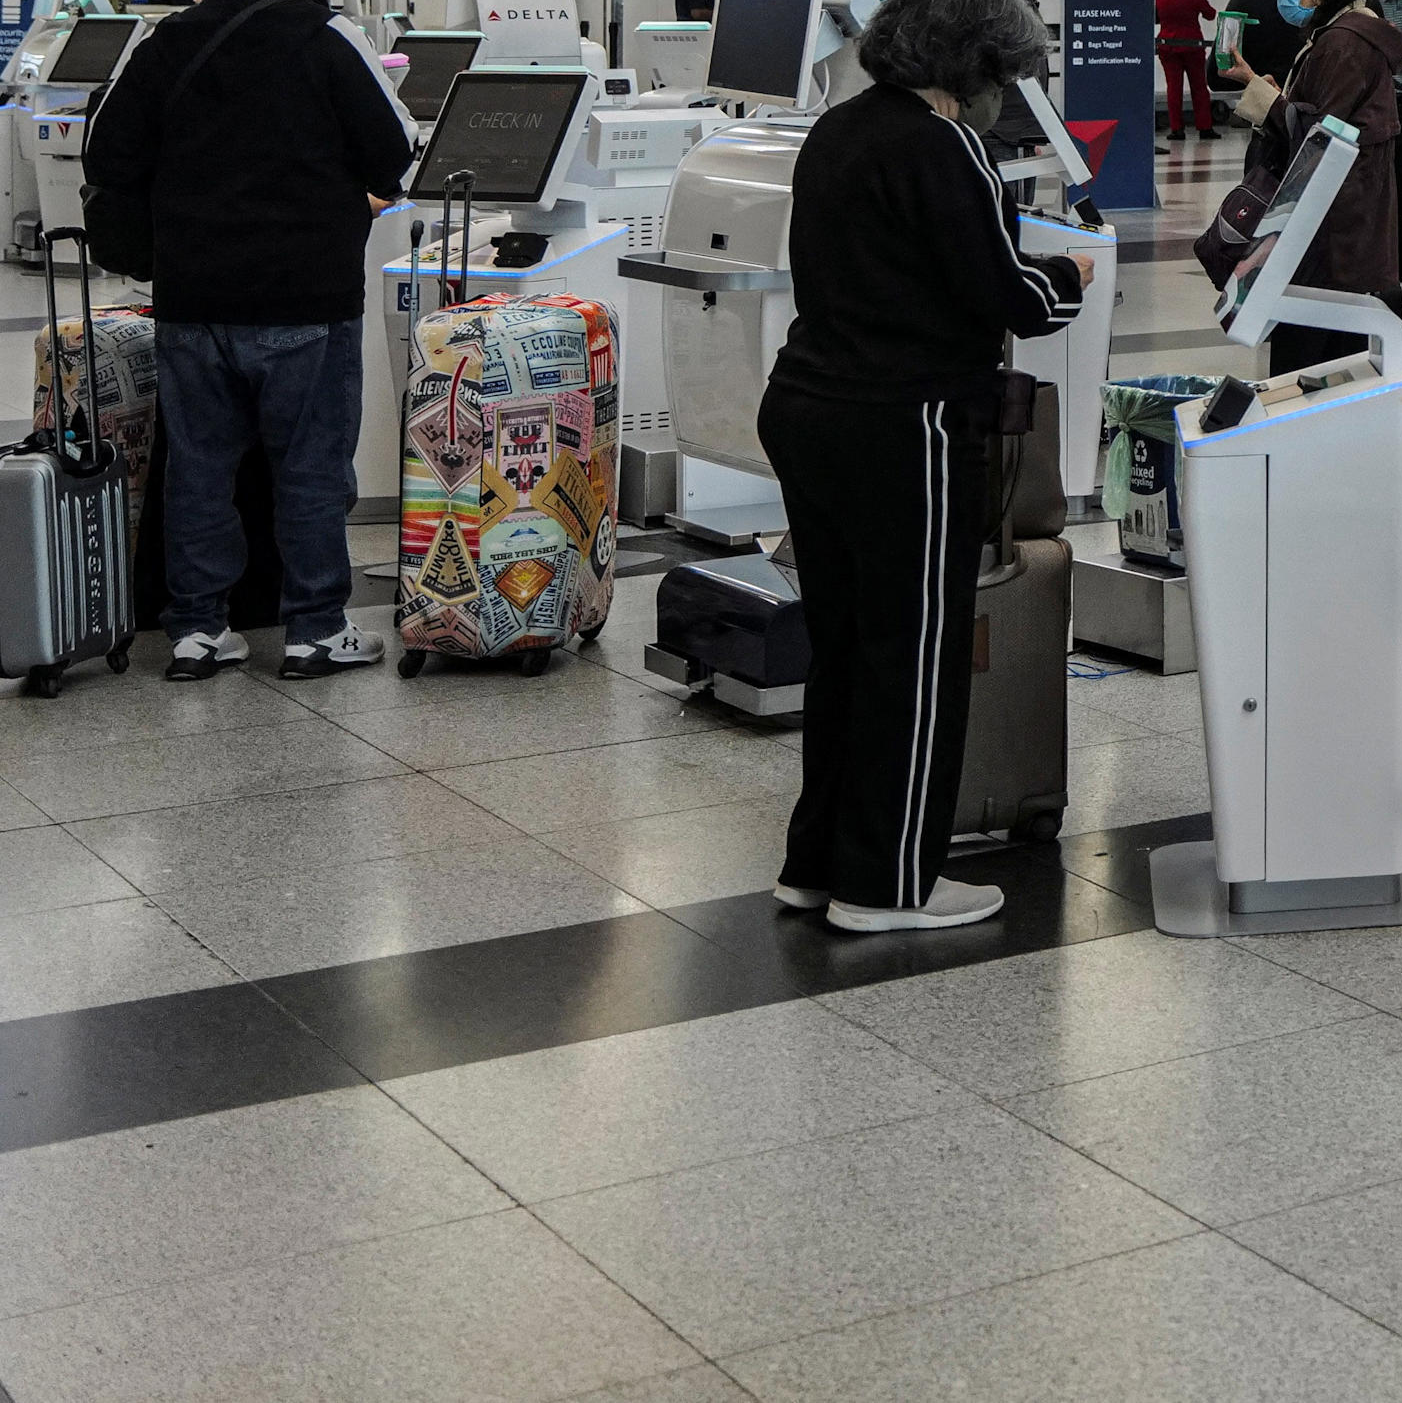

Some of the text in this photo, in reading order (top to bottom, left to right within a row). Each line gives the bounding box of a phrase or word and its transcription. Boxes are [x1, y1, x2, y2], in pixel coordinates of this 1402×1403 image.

[508, 10, 569, 19] DELTA
[469, 112, 543, 129] CHECK IN
[1131, 478, 1153, 489] ecycling
